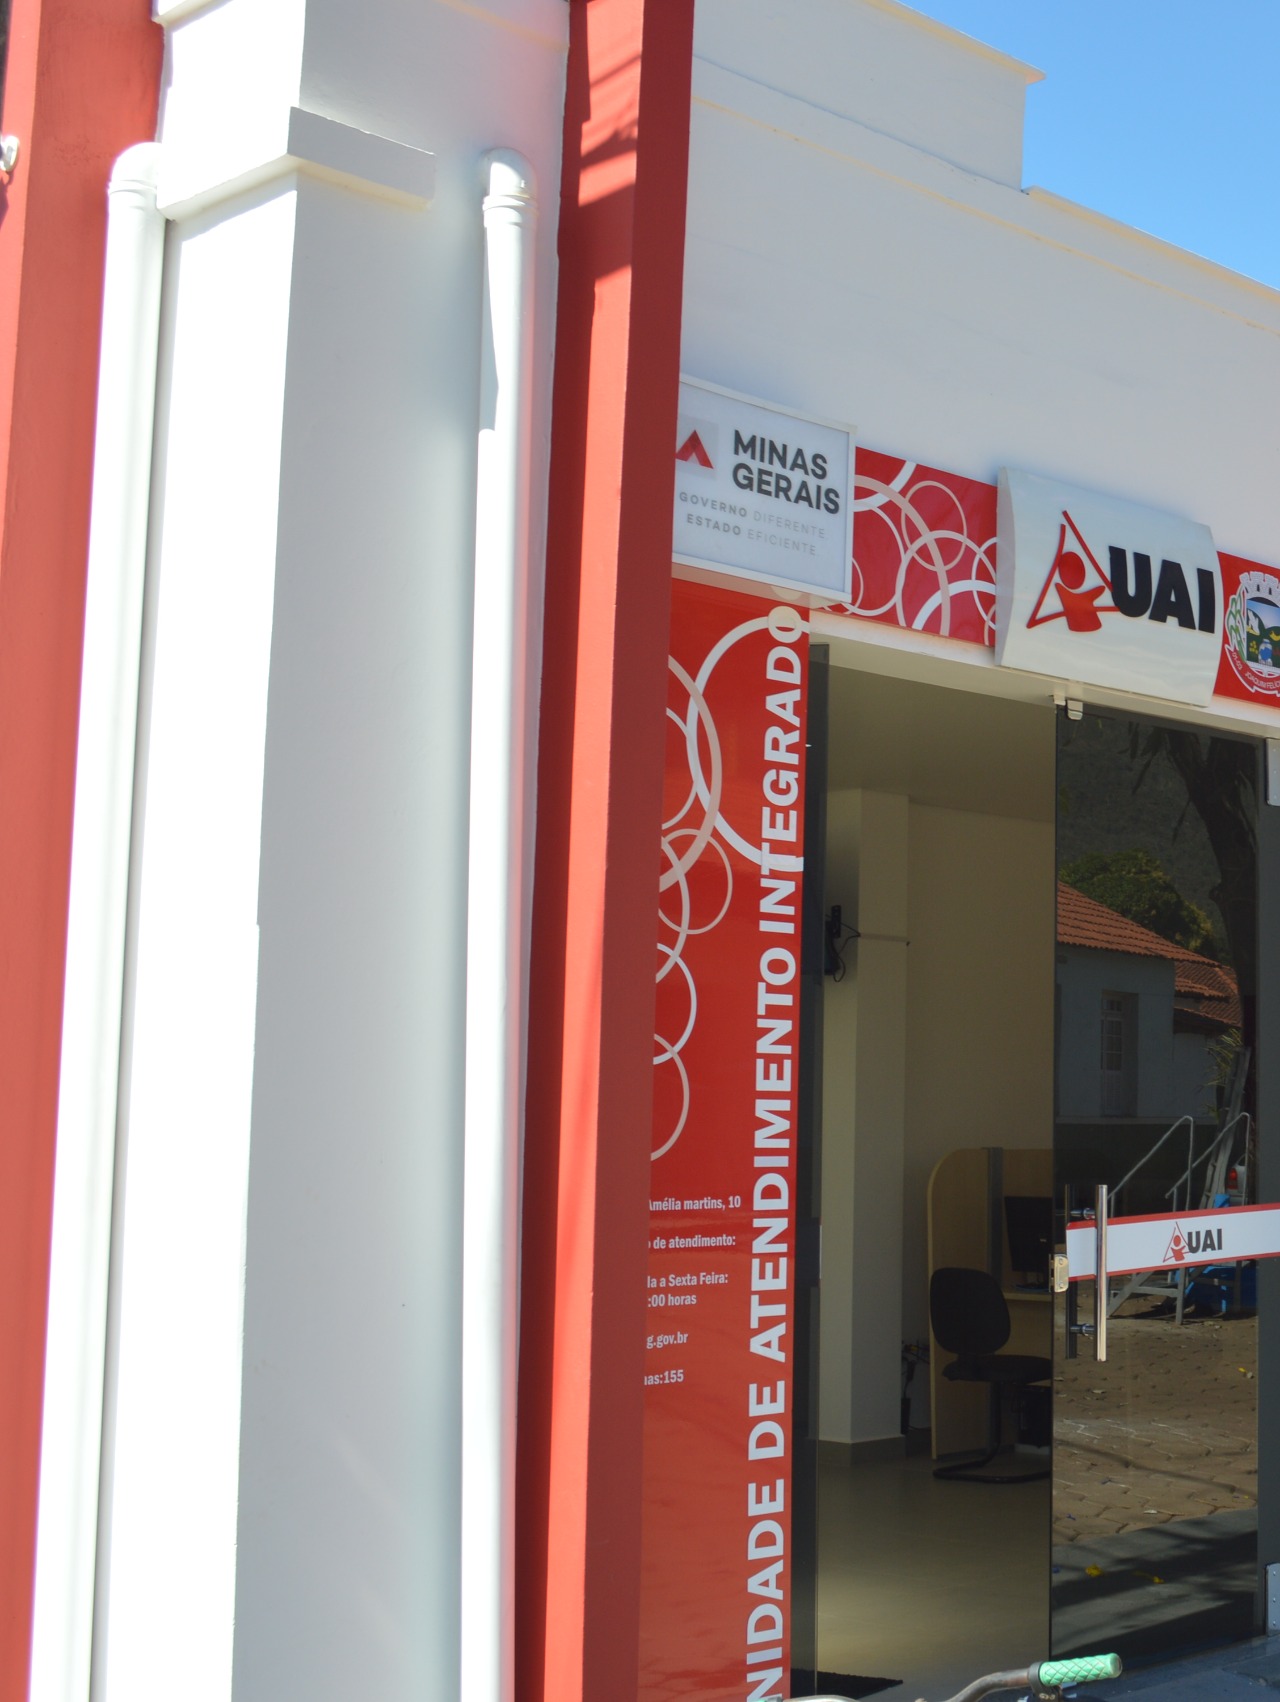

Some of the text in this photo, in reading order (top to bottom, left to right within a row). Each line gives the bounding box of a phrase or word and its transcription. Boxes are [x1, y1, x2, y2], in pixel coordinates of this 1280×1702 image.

[733, 429, 828, 480] MINAS
[732, 462, 840, 515] GERAIS
[679, 491, 826, 539] GOVERNO DIFERENTE
[686, 513, 817, 556] ESTADO EFICIENTE
[1108, 545, 1216, 634] UAI
[758, 605, 803, 935] INTEGRADO
[749, 947, 797, 1363] ATENDIMENTO
[683, 1196, 726, 1211] martins,
[728, 1195, 742, 1209] 10
[653, 1236, 666, 1249] de
[668, 1233, 736, 1249] atendimento:
[1187, 1228, 1223, 1254] UAI
[659, 1277, 666, 1287] a
[668, 1273, 697, 1286] Sexta
[699, 1271, 729, 1285] Feira:
[668, 1293, 697, 1306] horas
[646, 1331, 689, 1350] g.gov.br
[748, 1380, 786, 1461] DE
